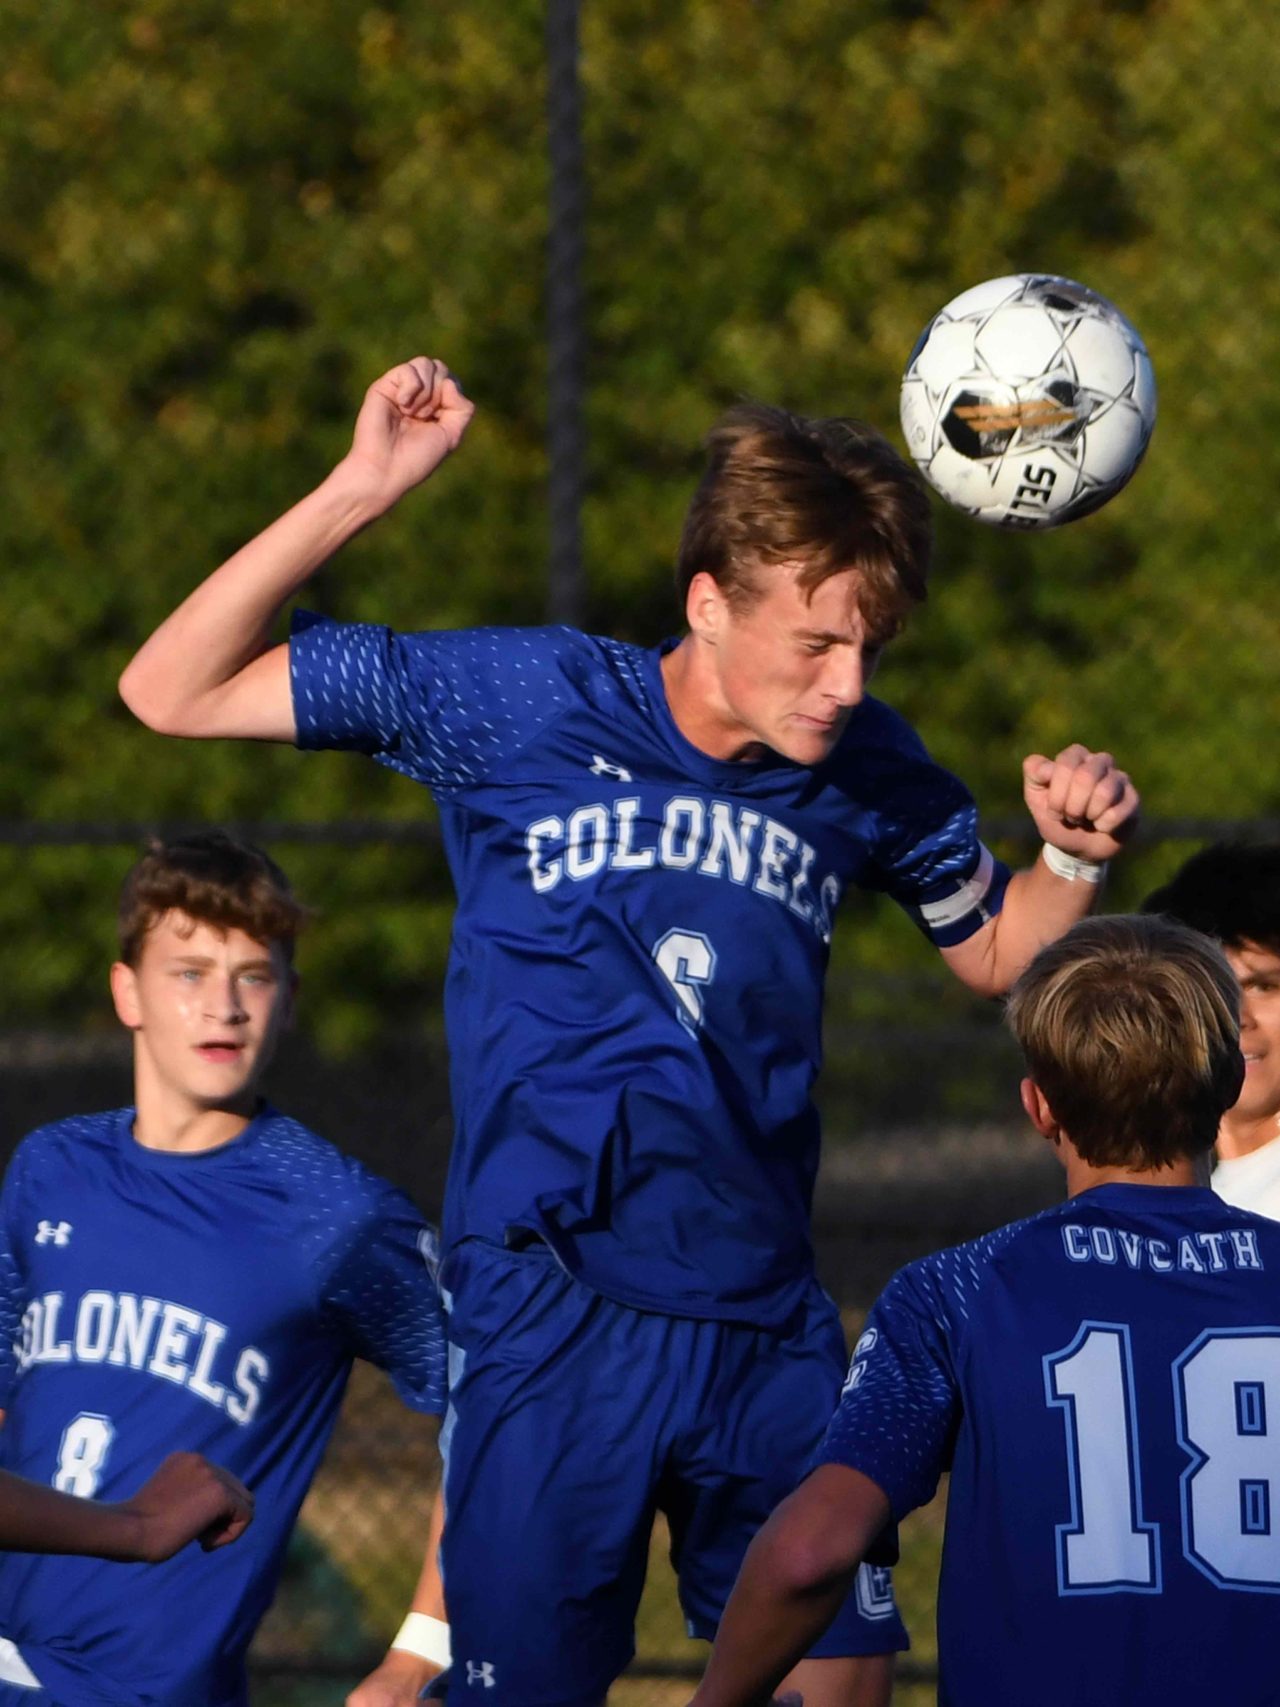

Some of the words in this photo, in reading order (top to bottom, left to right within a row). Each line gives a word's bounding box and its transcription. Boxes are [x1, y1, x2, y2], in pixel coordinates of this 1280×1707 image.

[525, 795, 842, 944] COLONELS
[1060, 1223, 1265, 1274] COVCATH
[12, 1289, 270, 1426] OLONELS
[52, 1411, 117, 1500] 8
